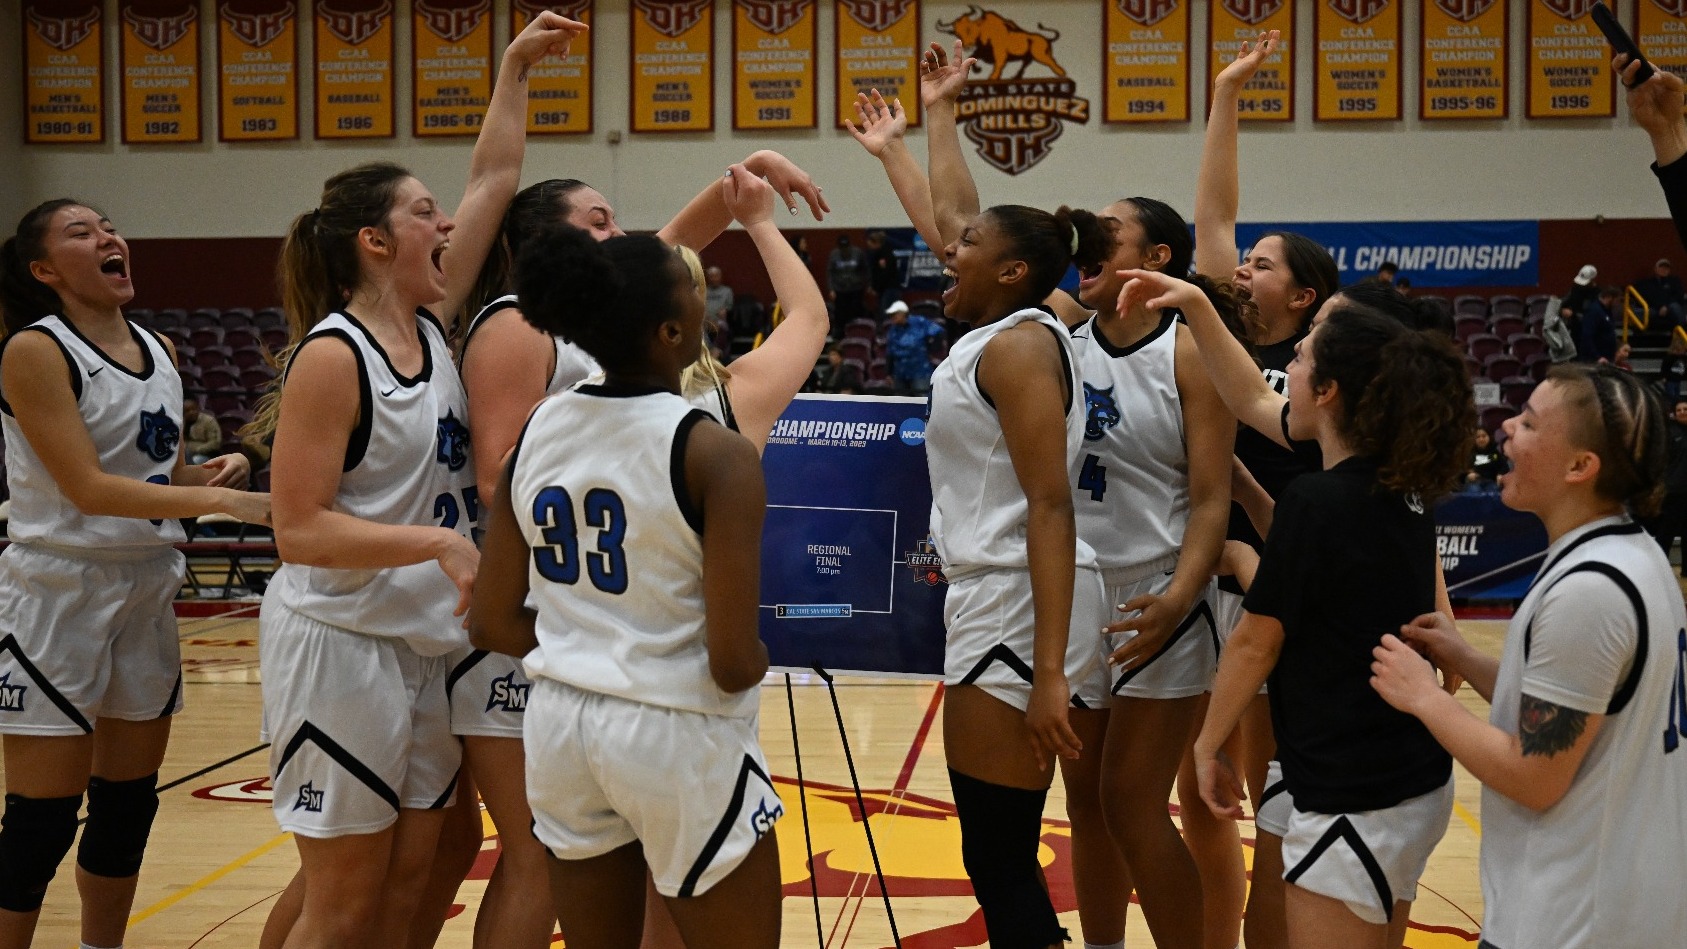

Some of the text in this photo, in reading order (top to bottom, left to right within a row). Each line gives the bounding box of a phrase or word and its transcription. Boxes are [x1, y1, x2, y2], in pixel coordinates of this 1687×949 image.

[1341, 29, 1374, 37] CCAA
[1446, 25, 1480, 35] CCAA
[1554, 24, 1587, 34] CCAA
[1129, 30, 1163, 40] CCAA
[655, 41, 687, 50] CCAA
[758, 39, 790, 48] CCAA
[861, 35, 893, 46] CCAA
[1321, 40, 1394, 49] CONFERENCE
[1426, 38, 1500, 48] CONFERENCE
[437, 47, 467, 56] CCAA
[1110, 42, 1184, 52] CONFERENCE
[242, 51, 272, 60] CCAA
[338, 49, 369, 58] CCAA
[636, 52, 707, 62] CONFERENCE
[738, 50, 811, 61] CONFERENCE
[841, 48, 914, 58] CONFERENCE
[1327, 53, 1388, 63] CHAMPION
[1432, 51, 1494, 61] CHAMPION
[1539, 50, 1602, 60] CHAMPION
[48, 55, 78, 63] CCAA
[145, 54, 175, 63] CCAA
[417, 58, 487, 68] CONFERENCE
[1115, 54, 1178, 65] CHAMPION
[223, 63, 292, 73] CONFERENCE
[320, 60, 388, 71] CONFERENCE
[643, 65, 702, 75] CHAMPION
[744, 62, 804, 73] CHAMPION
[847, 60, 908, 70] CHAMPION
[30, 66, 98, 76] CONFERENCE
[127, 66, 194, 76] CONFERENCE
[423, 70, 482, 80] CHAMPION
[36, 78, 92, 88] CHAMPION
[132, 78, 190, 88] CHAMPION
[229, 75, 286, 85] CHAMPION
[325, 73, 383, 83] CHAMPION
[1117, 77, 1175, 87] BASEBALL
[1427, 77, 1501, 88] BASKETBALL
[1550, 77, 1592, 87] SOCCER
[961, 83, 1070, 96] CAL STATE
[1336, 80, 1379, 90] SOCCER
[232, 95, 286, 105] SOFTBALL
[327, 93, 381, 104] BASEBALL
[652, 92, 692, 101] SOCCER
[755, 90, 795, 100] SOCCER
[419, 97, 487, 107] BASKETBALL
[1127, 100, 1165, 113] 1994
[1238, 99, 1281, 112] 94-95
[1338, 98, 1376, 112] 1995
[1430, 97, 1496, 110] 1995-96
[1551, 95, 1589, 109] 1996
[31, 104, 97, 113] BASKETBALL
[142, 103, 181, 113] SOCCER
[534, 112, 569, 125] 1987
[654, 109, 691, 122] 1988
[758, 107, 791, 121] 1991
[241, 118, 277, 131] 1983
[336, 116, 373, 130] 1986
[981, 113, 1047, 129] HILLS
[37, 121, 93, 134] 1980-81
[144, 121, 179, 134] 1982
[1353, 244, 1532, 272] CHAMPIONSHIP
[901, 430, 926, 439] NCAA
[1078, 453, 1107, 502] 4
[1444, 525, 1484, 534] WOMEN'S
[532, 485, 629, 595] 33
[807, 544, 852, 556] REGIONAL
[816, 556, 842, 567] FINAL
[911, 556, 932, 566] ELITE
[816, 567, 830, 575] 7:00
[491, 675, 530, 712] SM
[297, 783, 324, 812] SM
